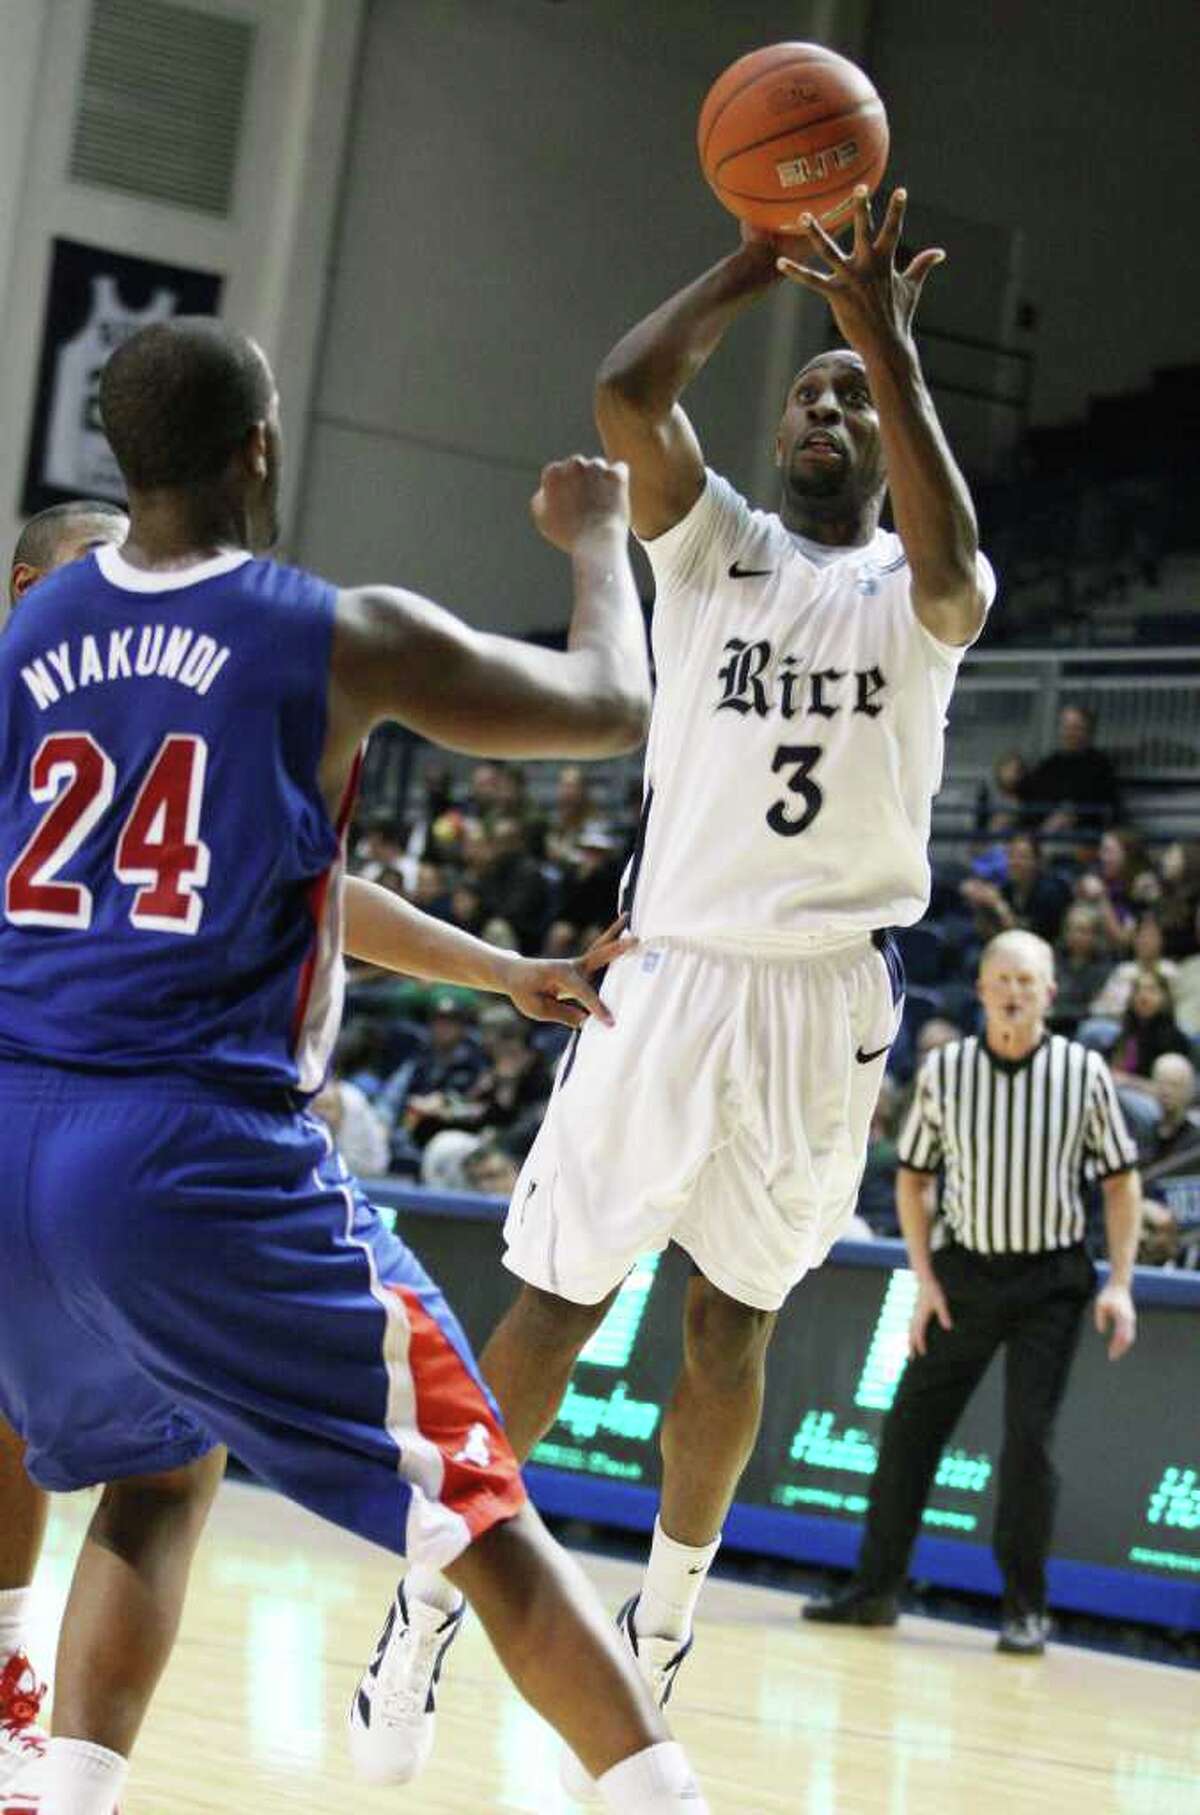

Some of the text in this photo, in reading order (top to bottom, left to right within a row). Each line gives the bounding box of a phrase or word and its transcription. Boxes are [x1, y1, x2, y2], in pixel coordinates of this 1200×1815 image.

[21, 624, 231, 710] NYAKUNDI
[717, 637, 887, 719] Rice
[5, 731, 211, 936] 24
[766, 745, 823, 837] 3
